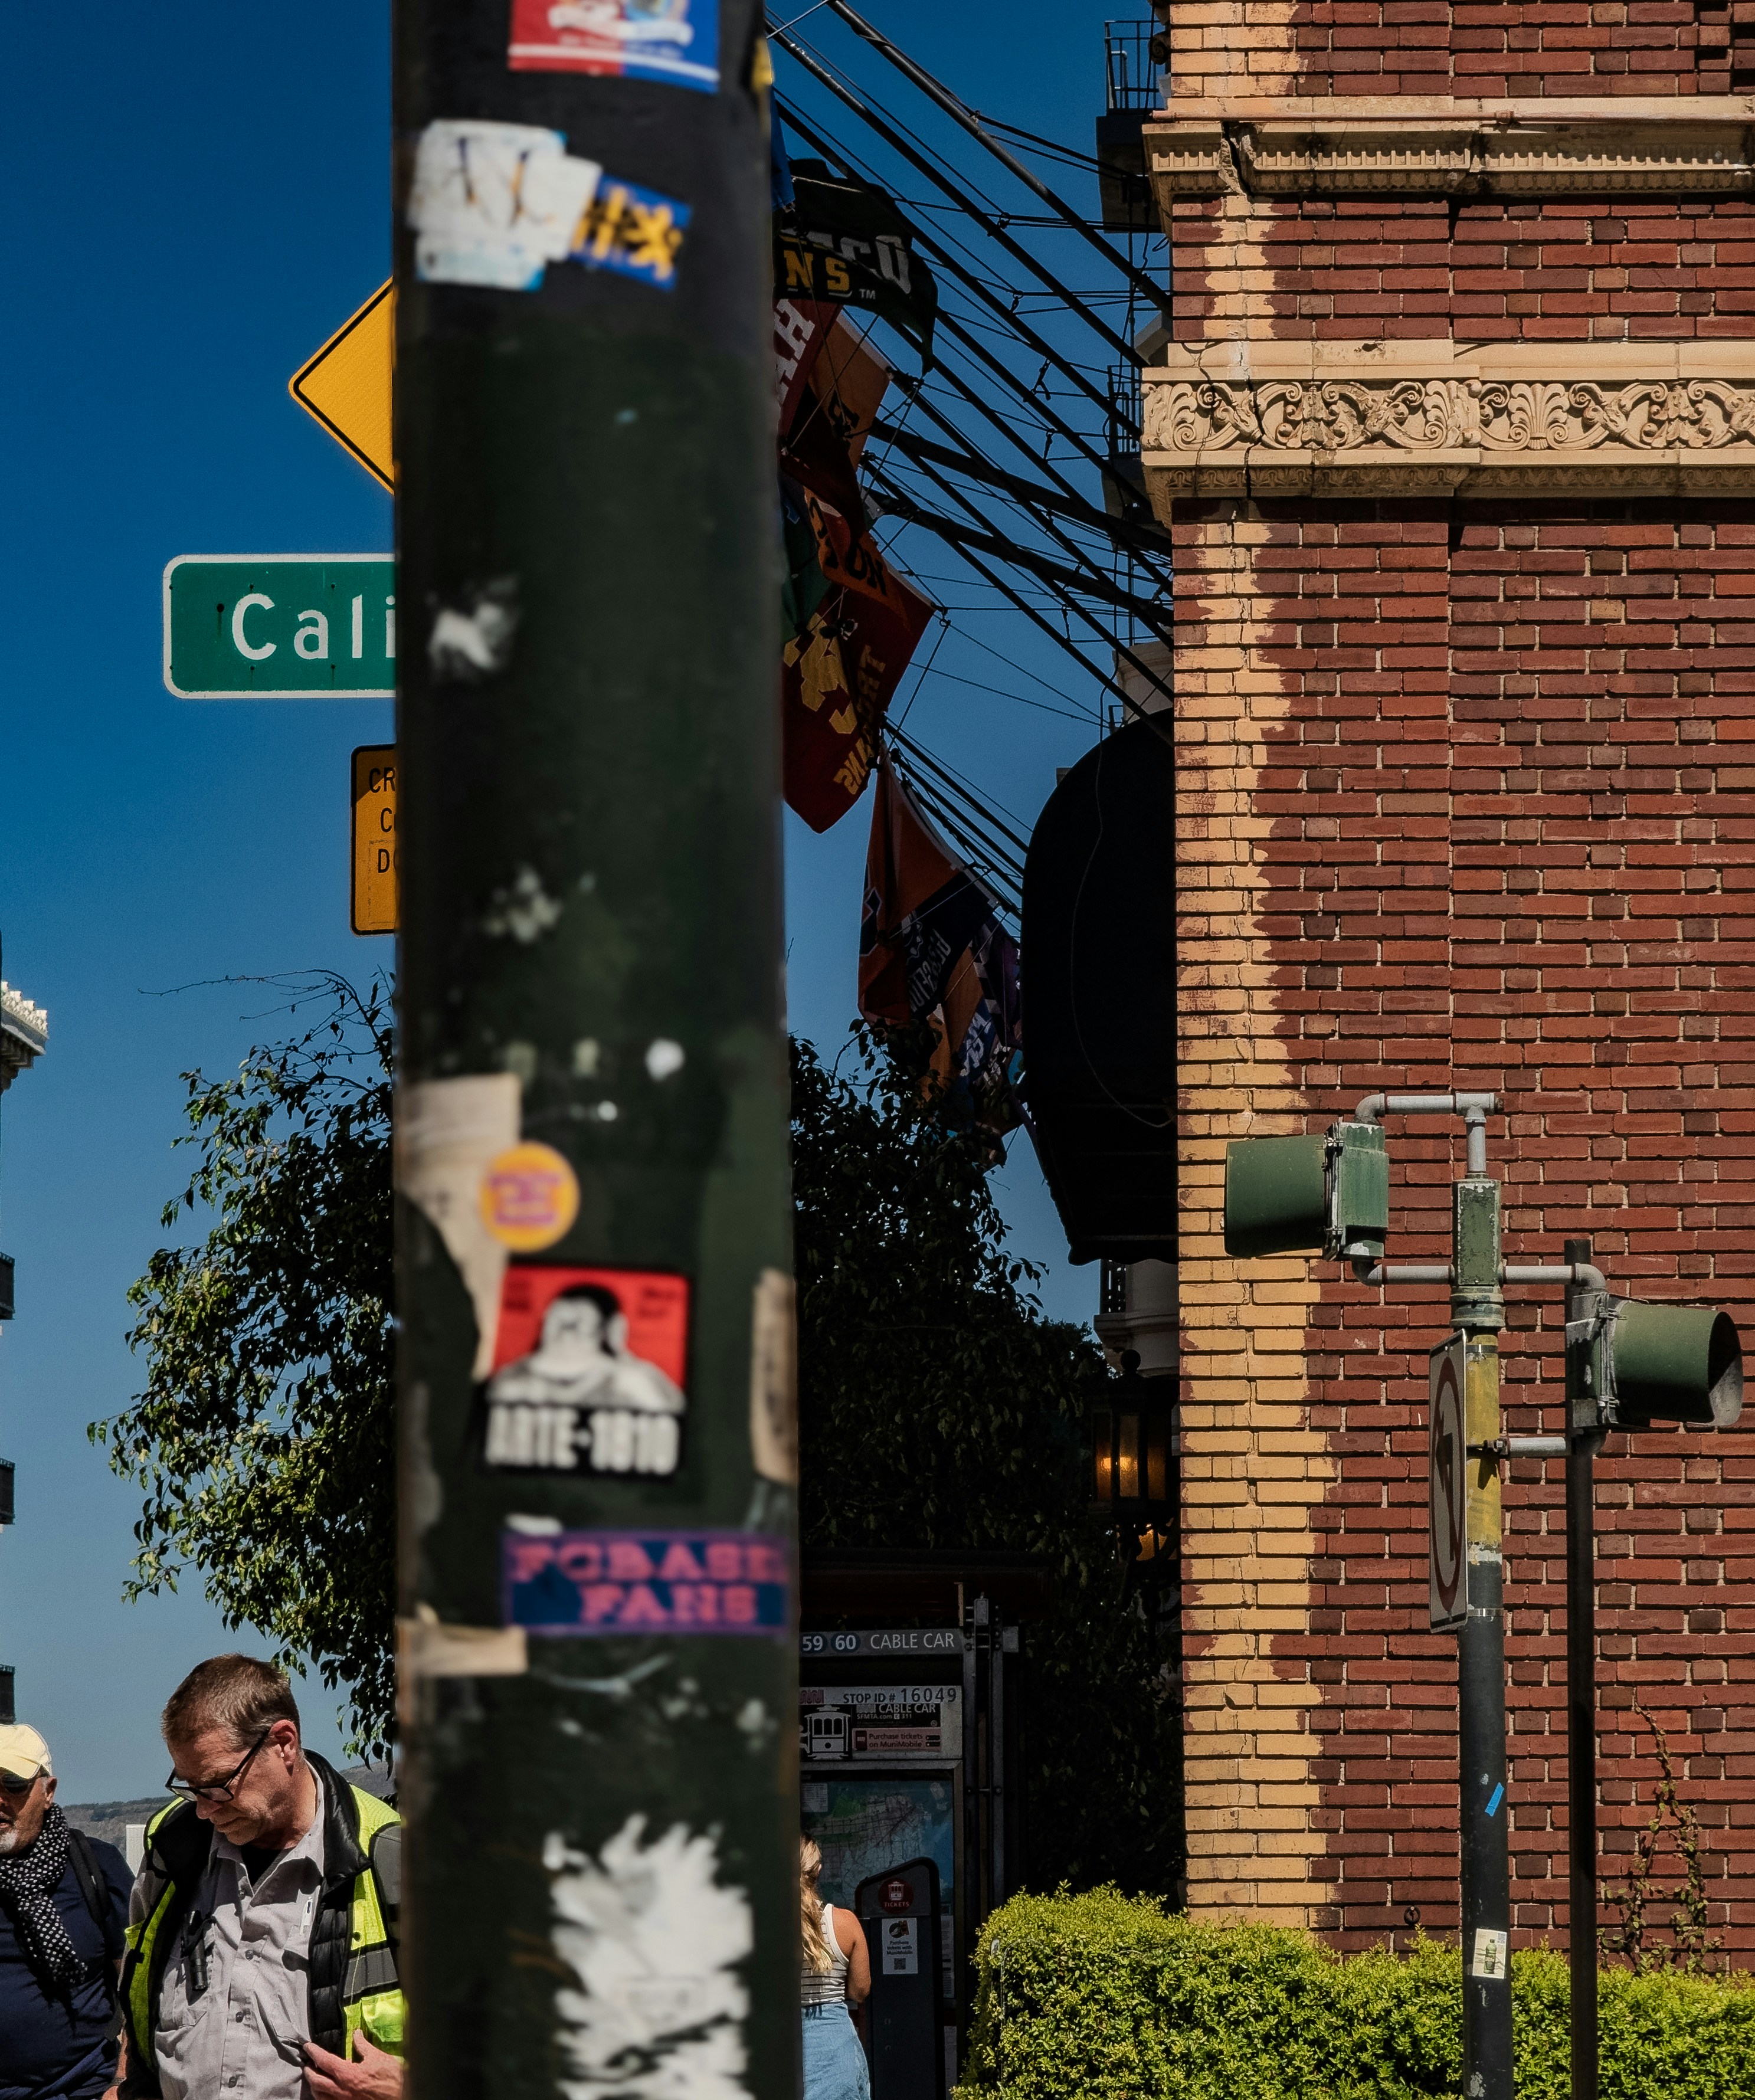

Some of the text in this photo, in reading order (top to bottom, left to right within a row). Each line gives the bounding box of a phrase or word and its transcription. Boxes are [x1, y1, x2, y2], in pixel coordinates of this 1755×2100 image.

[231, 593, 396, 660] Cali
[380, 807, 396, 833] C
[378, 848, 396, 873] D
[803, 1633, 954, 1651] 59 60 CABLE CAR
[843, 1688, 957, 1703] STOP ID # 16049
[878, 1703, 912, 1714] CABLE
[914, 1703, 936, 1713] CAR
